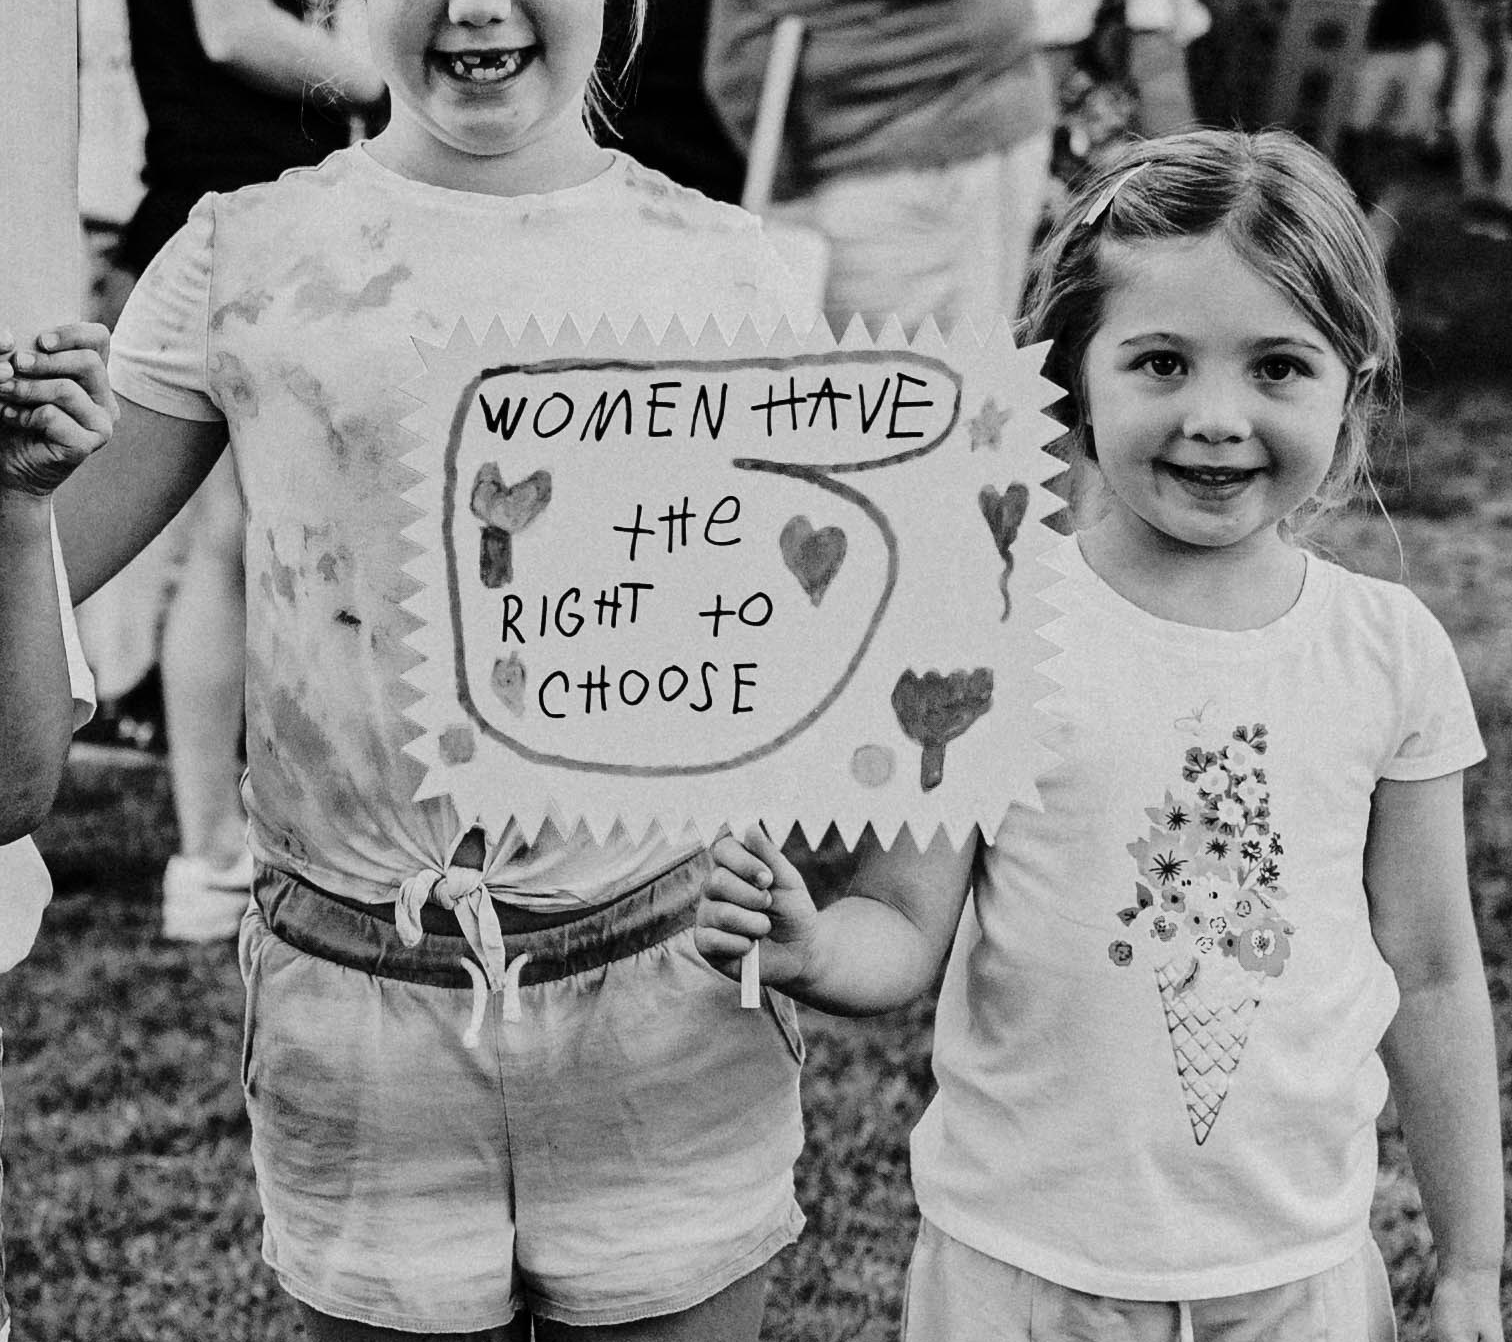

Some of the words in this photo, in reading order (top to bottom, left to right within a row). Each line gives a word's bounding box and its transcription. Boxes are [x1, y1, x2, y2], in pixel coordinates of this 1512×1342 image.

[480, 383, 727, 441] WOMEN
[751, 373, 933, 439] HAVE
[502, 583, 653, 643] RIGHT
[538, 662, 757, 717] CHOOSE
